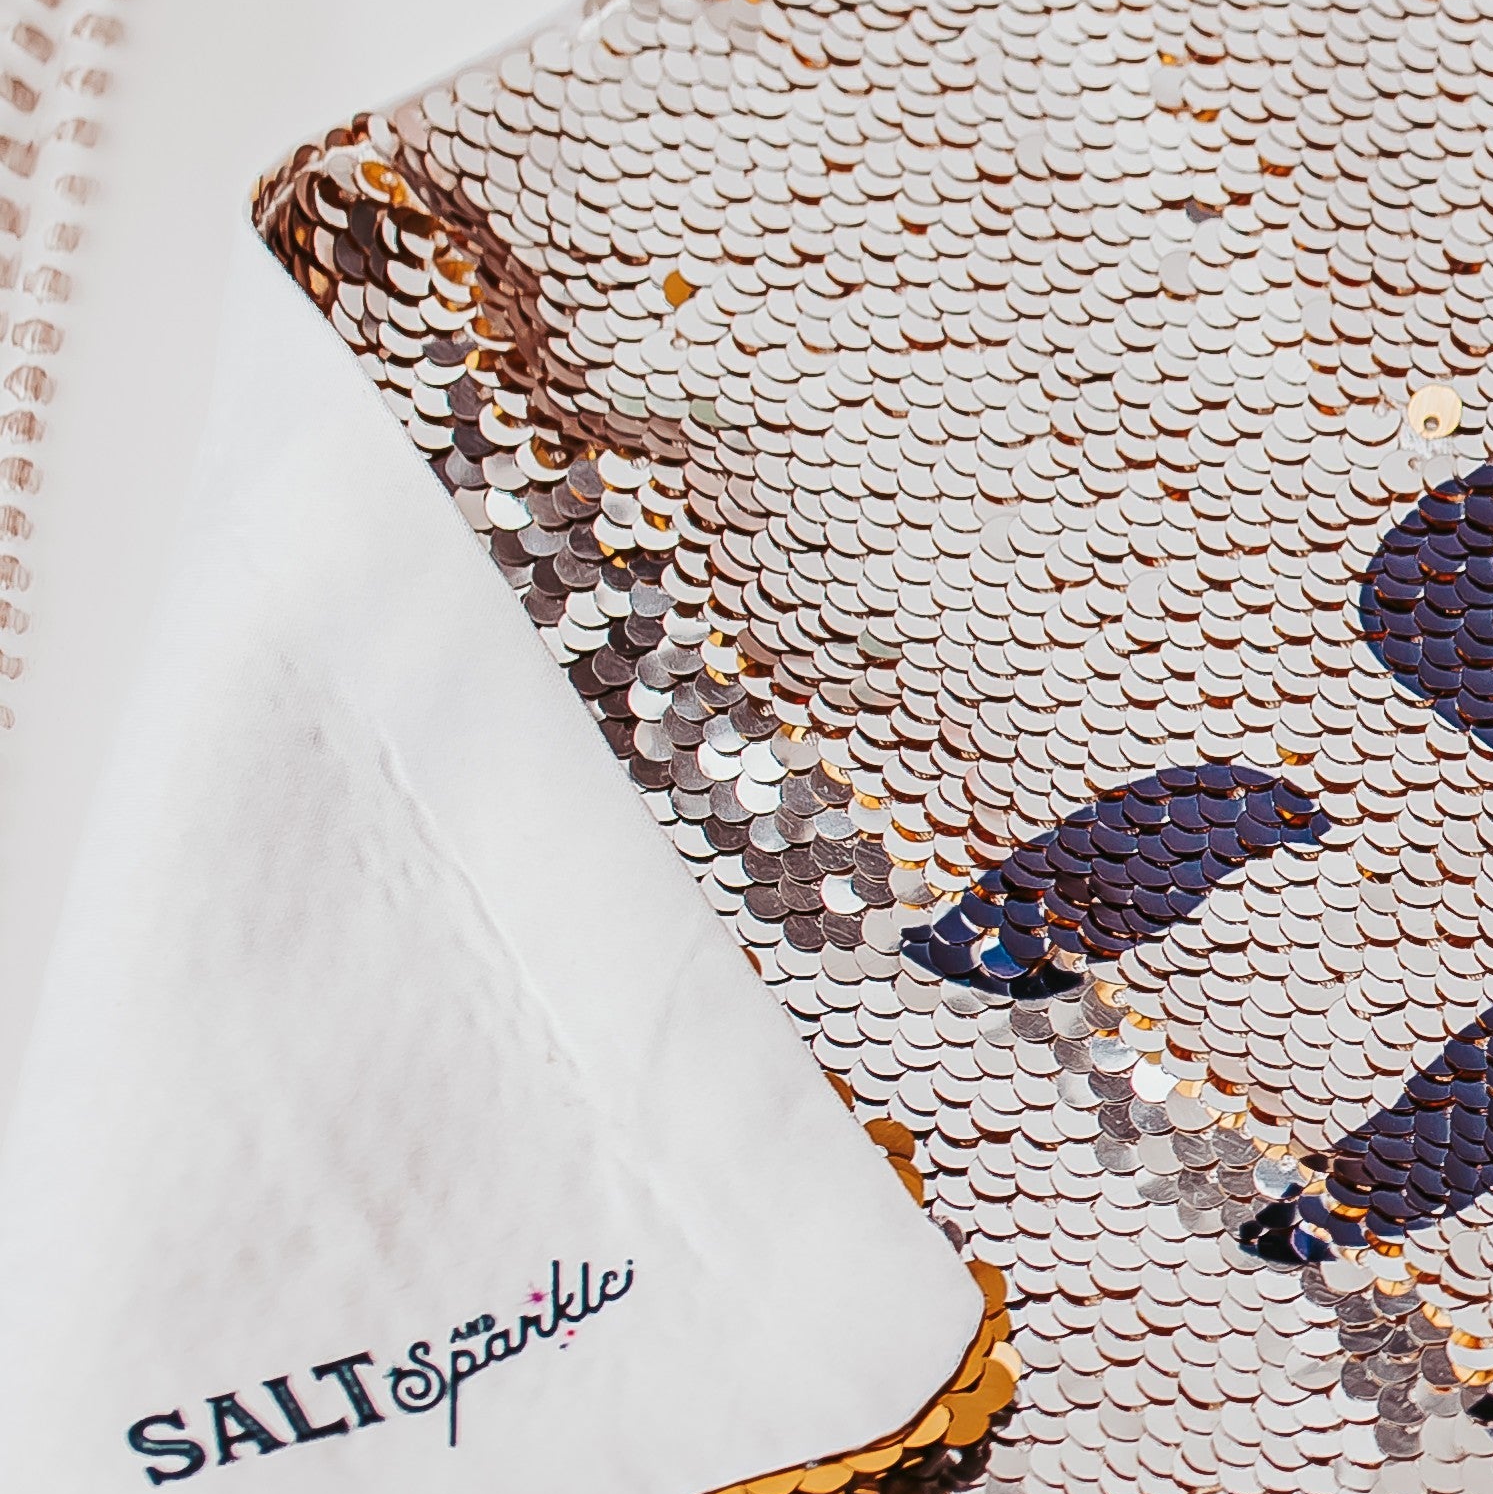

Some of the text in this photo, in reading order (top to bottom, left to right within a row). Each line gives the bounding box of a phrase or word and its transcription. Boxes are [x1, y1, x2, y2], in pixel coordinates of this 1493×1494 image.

[126, 1258, 634, 1486] SALT AND Sparkle
